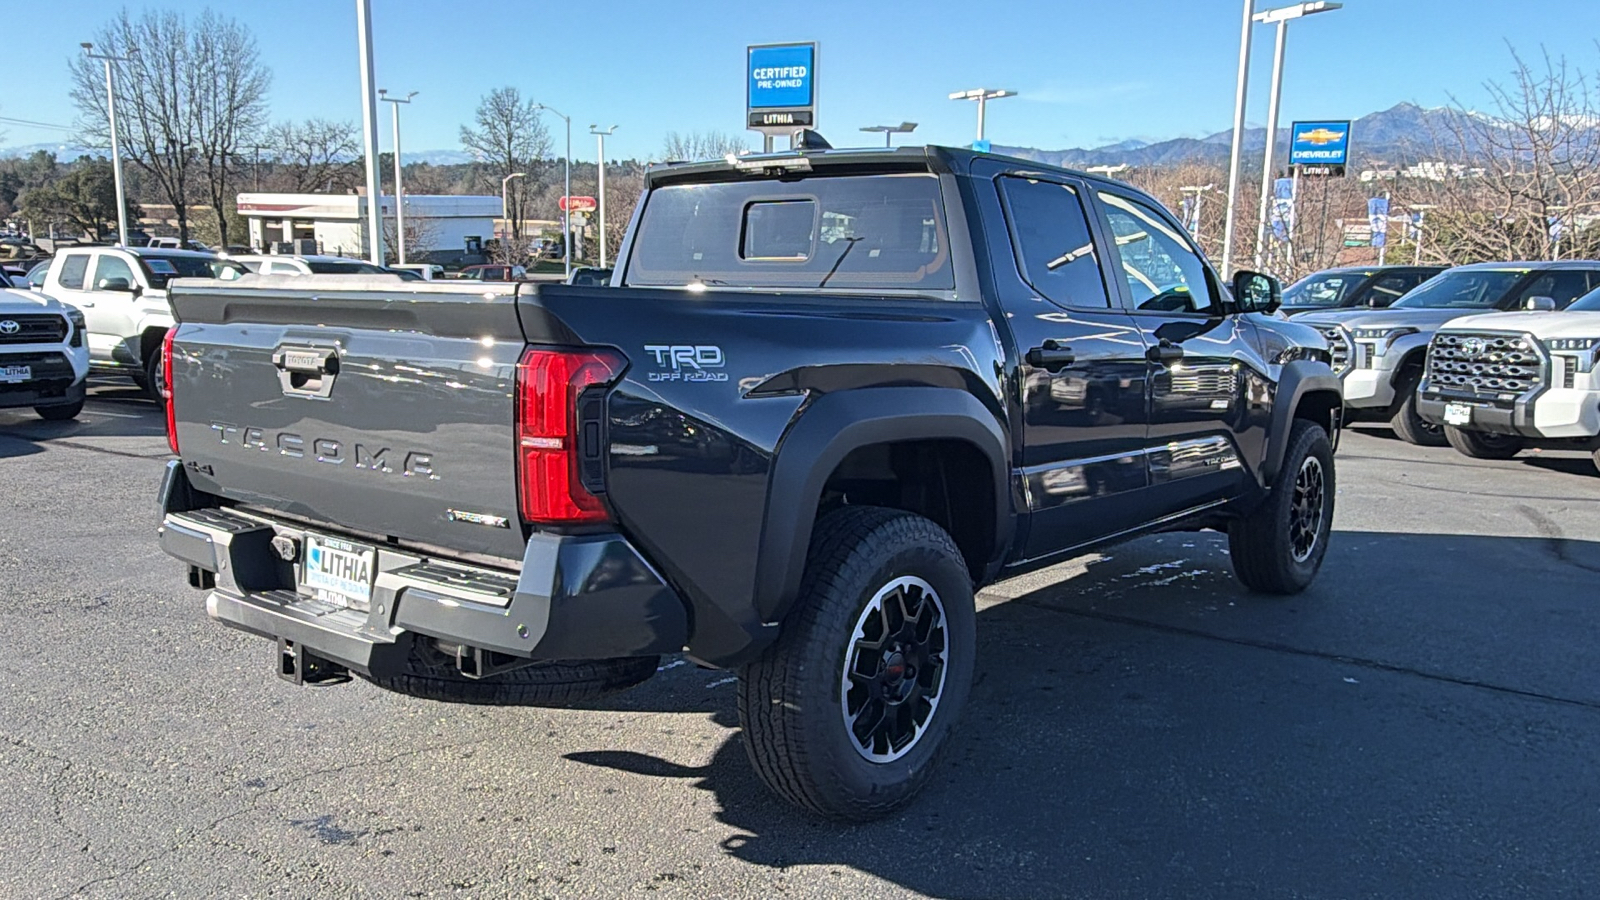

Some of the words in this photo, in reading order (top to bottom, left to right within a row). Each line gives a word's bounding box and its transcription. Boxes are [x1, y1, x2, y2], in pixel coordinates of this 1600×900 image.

[753, 66, 807, 79] CERTIFIED
[757, 79, 802, 89] PRE-OWNED
[763, 113, 794, 124] LITHIA
[288, 354, 317, 366] TOYOTA
[644, 345, 724, 370] TRD
[5, 368, 30, 376] LITHIA
[648, 373, 681, 382] OFF
[684, 372, 729, 382] ROAD
[210, 420, 440, 481] TACOMA
[321, 550, 369, 585] LITHIA
